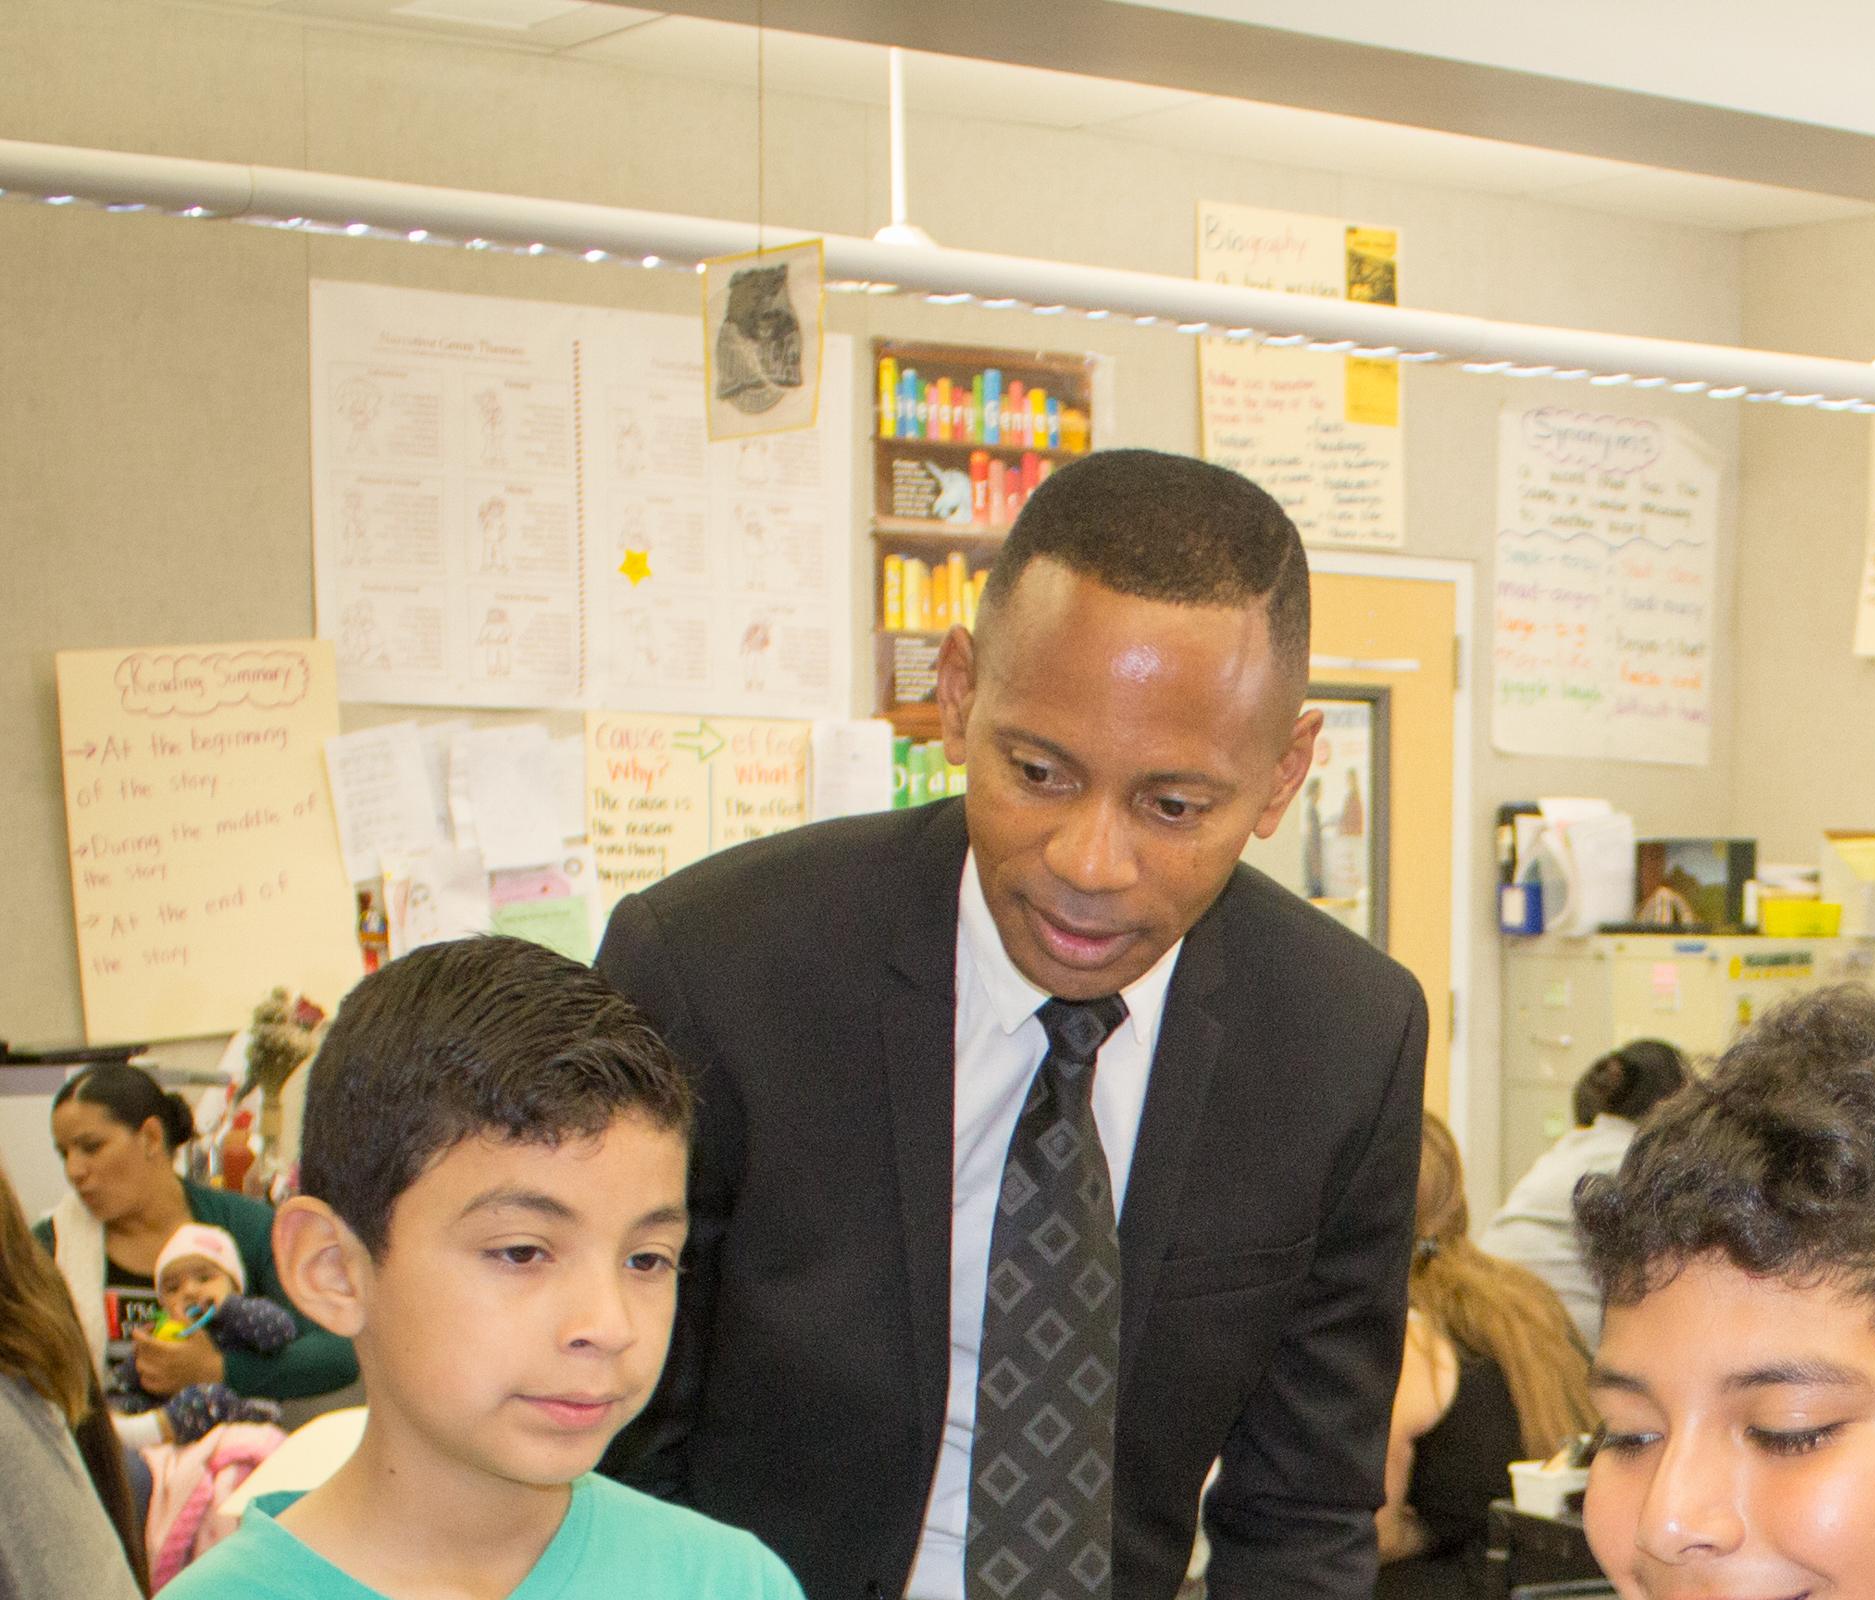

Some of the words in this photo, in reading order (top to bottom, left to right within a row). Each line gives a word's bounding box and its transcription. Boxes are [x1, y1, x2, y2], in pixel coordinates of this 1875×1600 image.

[882, 392, 974, 432] Literary
[128, 657, 205, 698] Reading
[212, 658, 293, 691] Summary
[100, 736, 132, 765] At
[151, 733, 182, 757] the
[190, 725, 288, 757] beginning
[76, 784, 102, 809] of
[120, 777, 152, 800] the
[91, 833, 162, 860] During
[172, 818, 201, 841] the
[216, 808, 280, 836] middle
[292, 792, 320, 818] of
[83, 867, 111, 890] the
[110, 915, 139, 939] At
[158, 902, 188, 926] the
[205, 887, 246, 915] end
[259, 870, 288, 898] of
[92, 952, 122, 977] the
